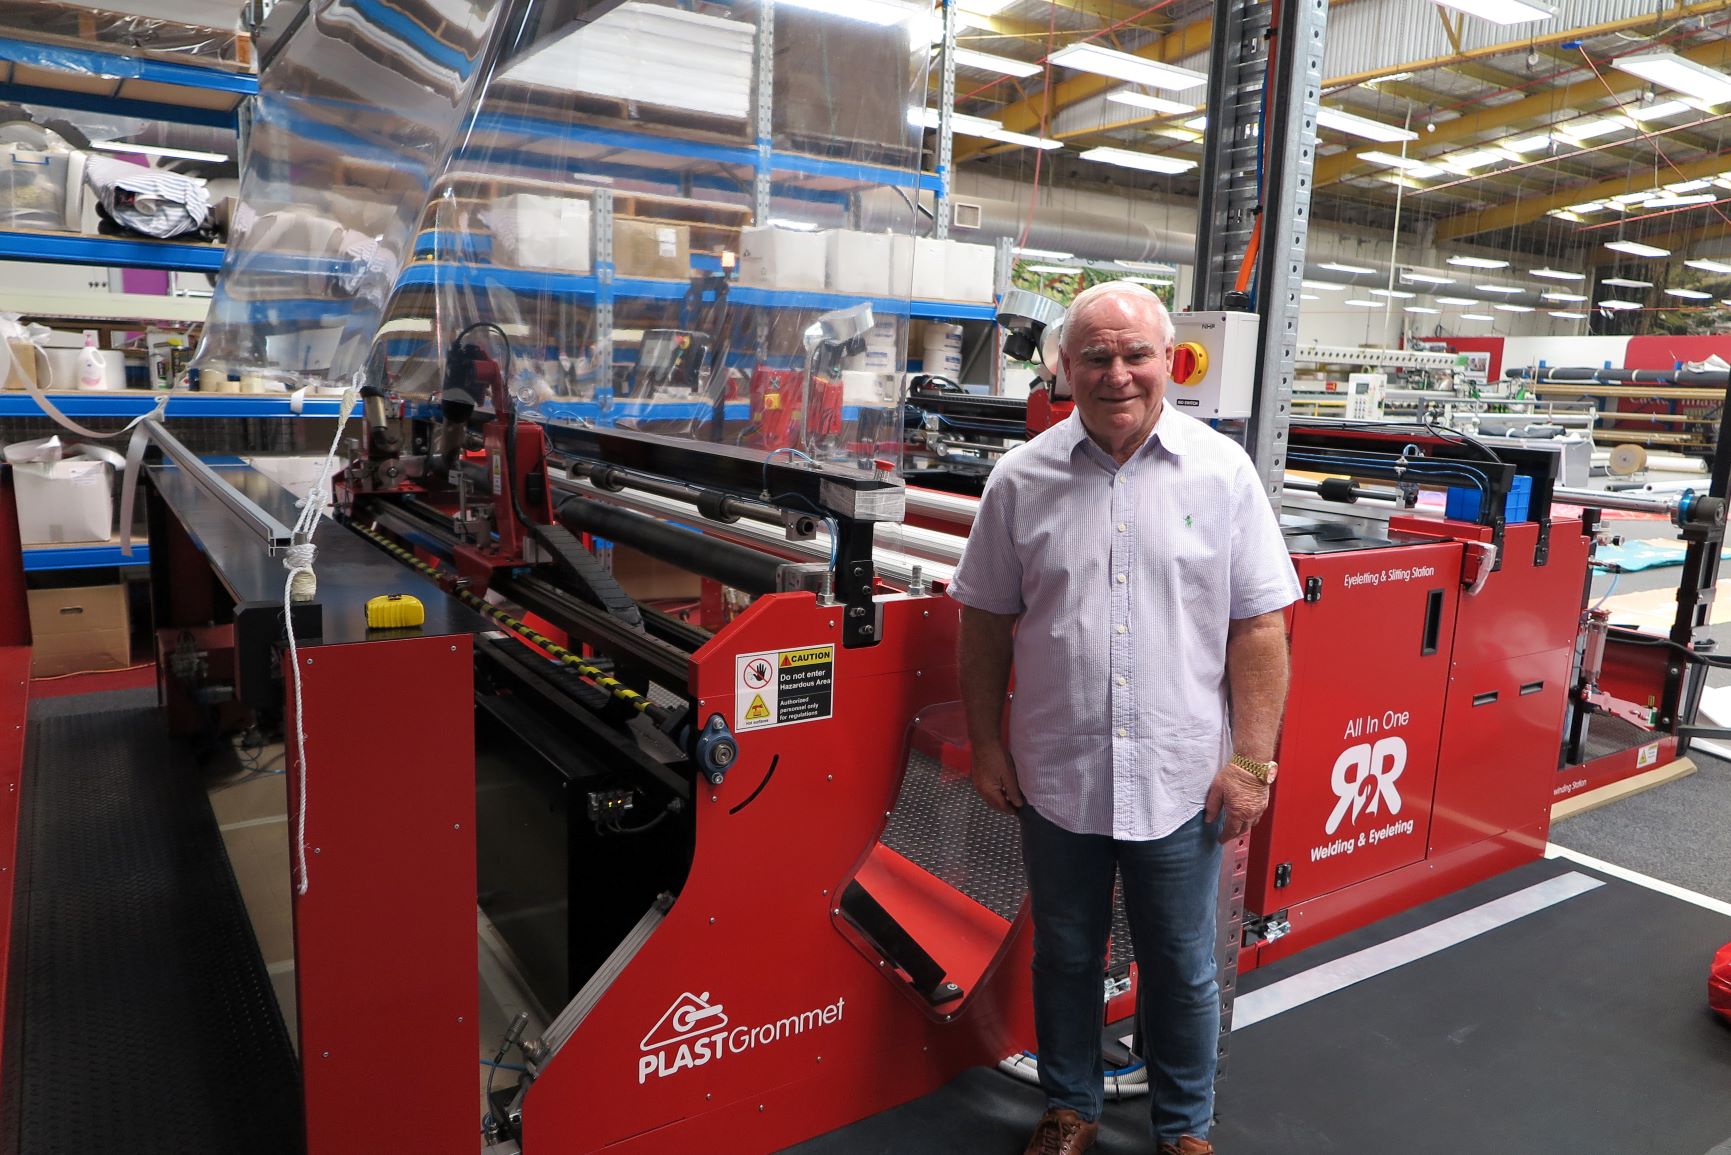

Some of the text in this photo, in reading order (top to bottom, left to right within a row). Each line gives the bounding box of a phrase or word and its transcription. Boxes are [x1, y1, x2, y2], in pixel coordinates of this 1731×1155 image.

[1380, 570, 1387, 582] &
[1411, 566, 1435, 578] Station
[791, 651, 831, 663] CAUTION
[780, 669, 826, 682] Do not enter
[780, 678, 831, 691] Hazardous Area
[780, 702, 819, 714] personnel only
[788, 710, 818, 720] regulations
[1344, 710, 1410, 740] All In One
[1310, 838, 1355, 862] Welding
[1357, 832, 1366, 847] &
